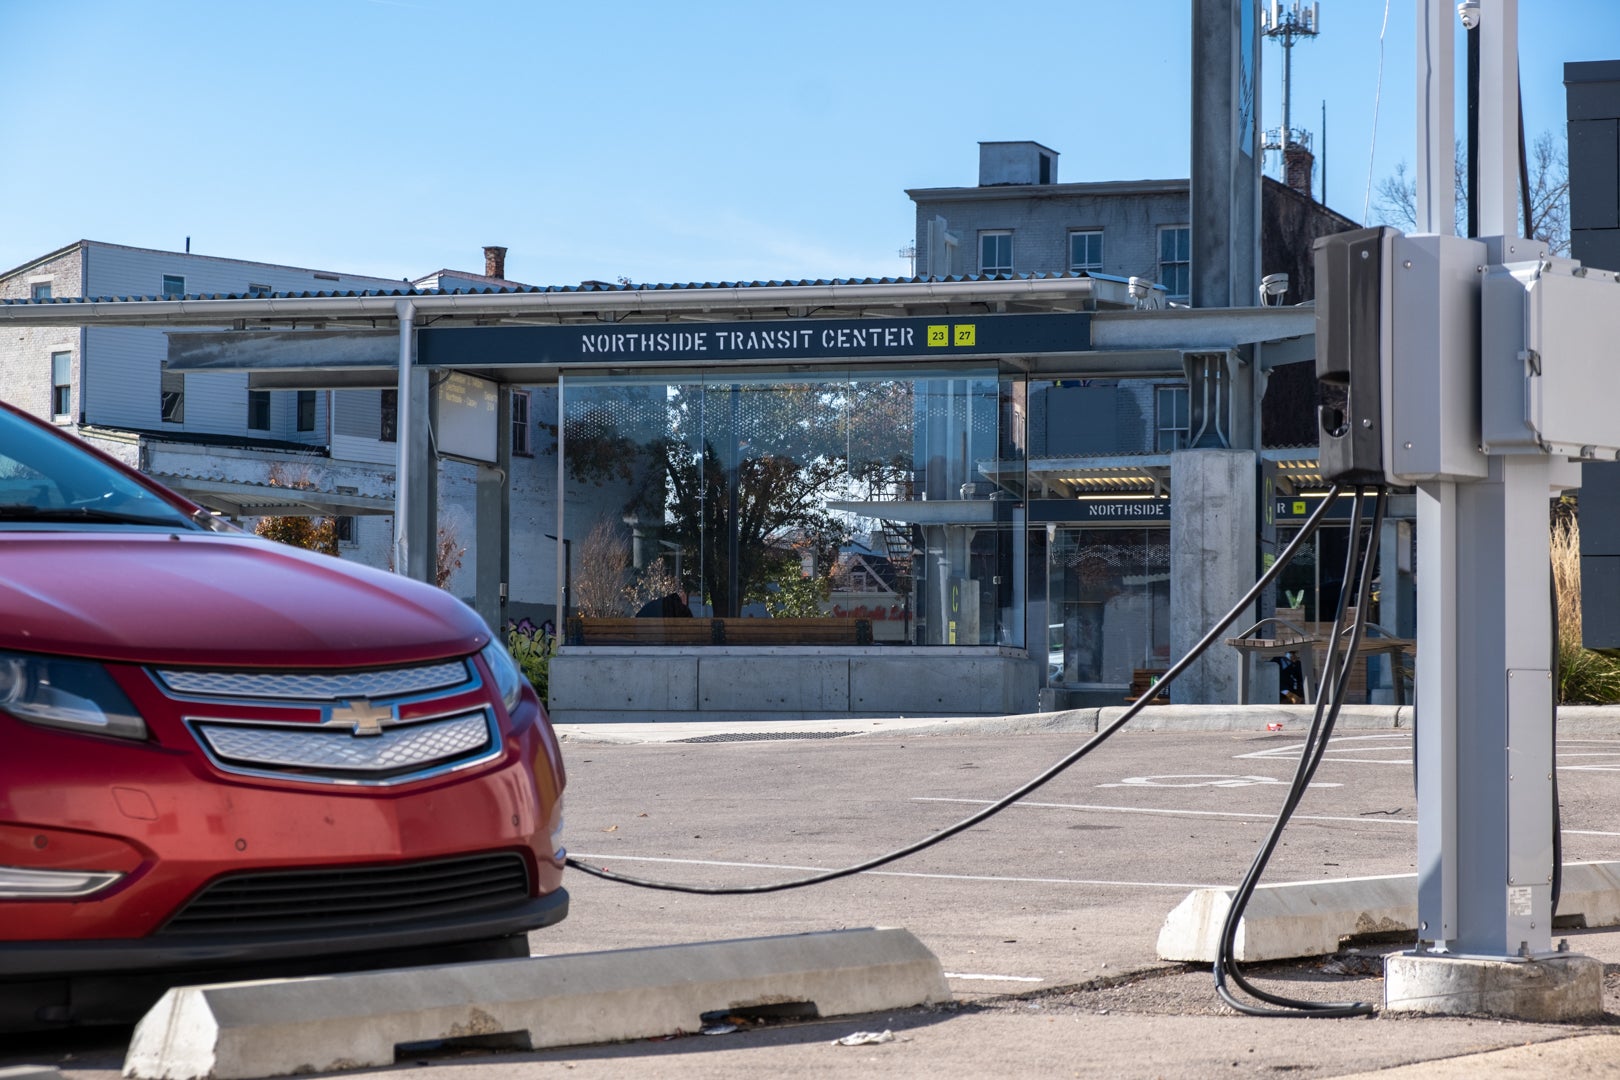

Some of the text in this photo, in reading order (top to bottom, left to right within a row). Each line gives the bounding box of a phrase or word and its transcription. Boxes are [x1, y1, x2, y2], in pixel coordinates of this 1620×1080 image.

[582, 327, 914, 353] NORTHSIDE TRANSIT CENTER
[932, 331, 945, 341] 23
[959, 331, 971, 340] 27
[1089, 504, 1164, 516] NORTHSIDE
